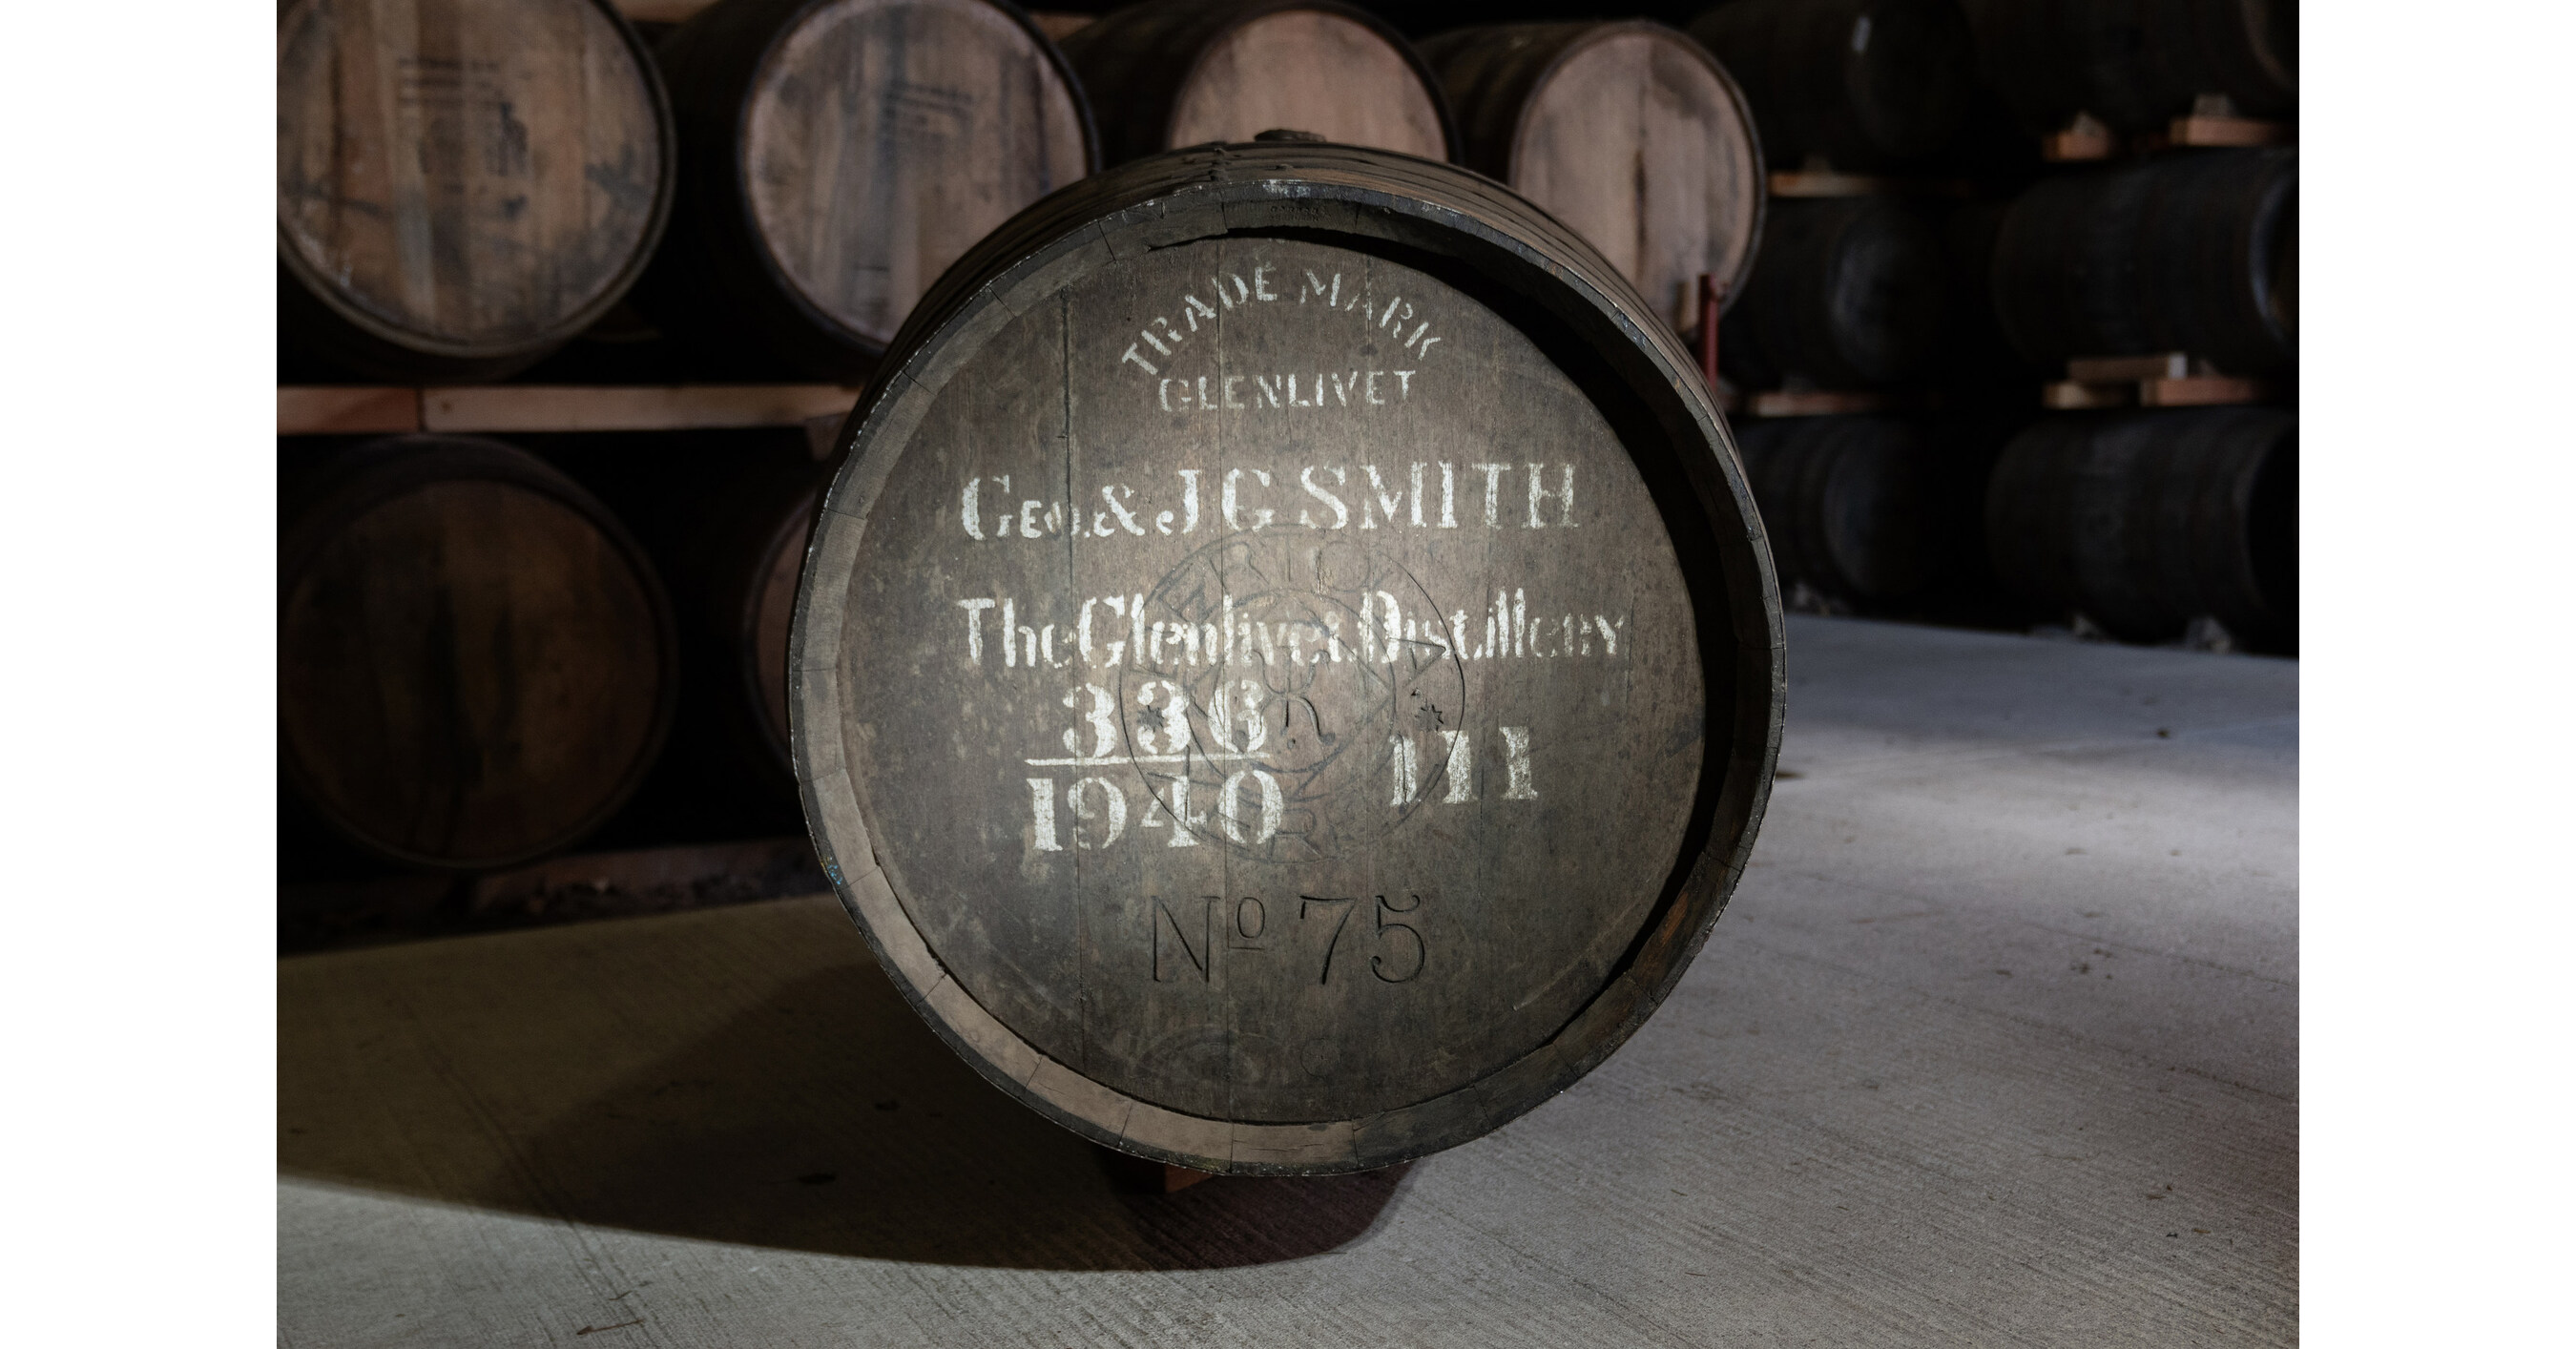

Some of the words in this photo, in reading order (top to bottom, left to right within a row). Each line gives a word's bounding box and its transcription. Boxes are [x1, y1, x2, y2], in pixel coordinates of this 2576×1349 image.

[1122, 266, 1277, 375] TRADE
[1299, 268, 1442, 361] MARK
[1158, 370, 1417, 412] GLENLIVET
[1300, 461, 1580, 530] SMITH
[957, 597, 1076, 669] The
[1061, 679, 1269, 758] 336
[1388, 726, 1539, 807] 111
[1027, 769, 1286, 852] 1940
[1298, 894, 1425, 985] 75
